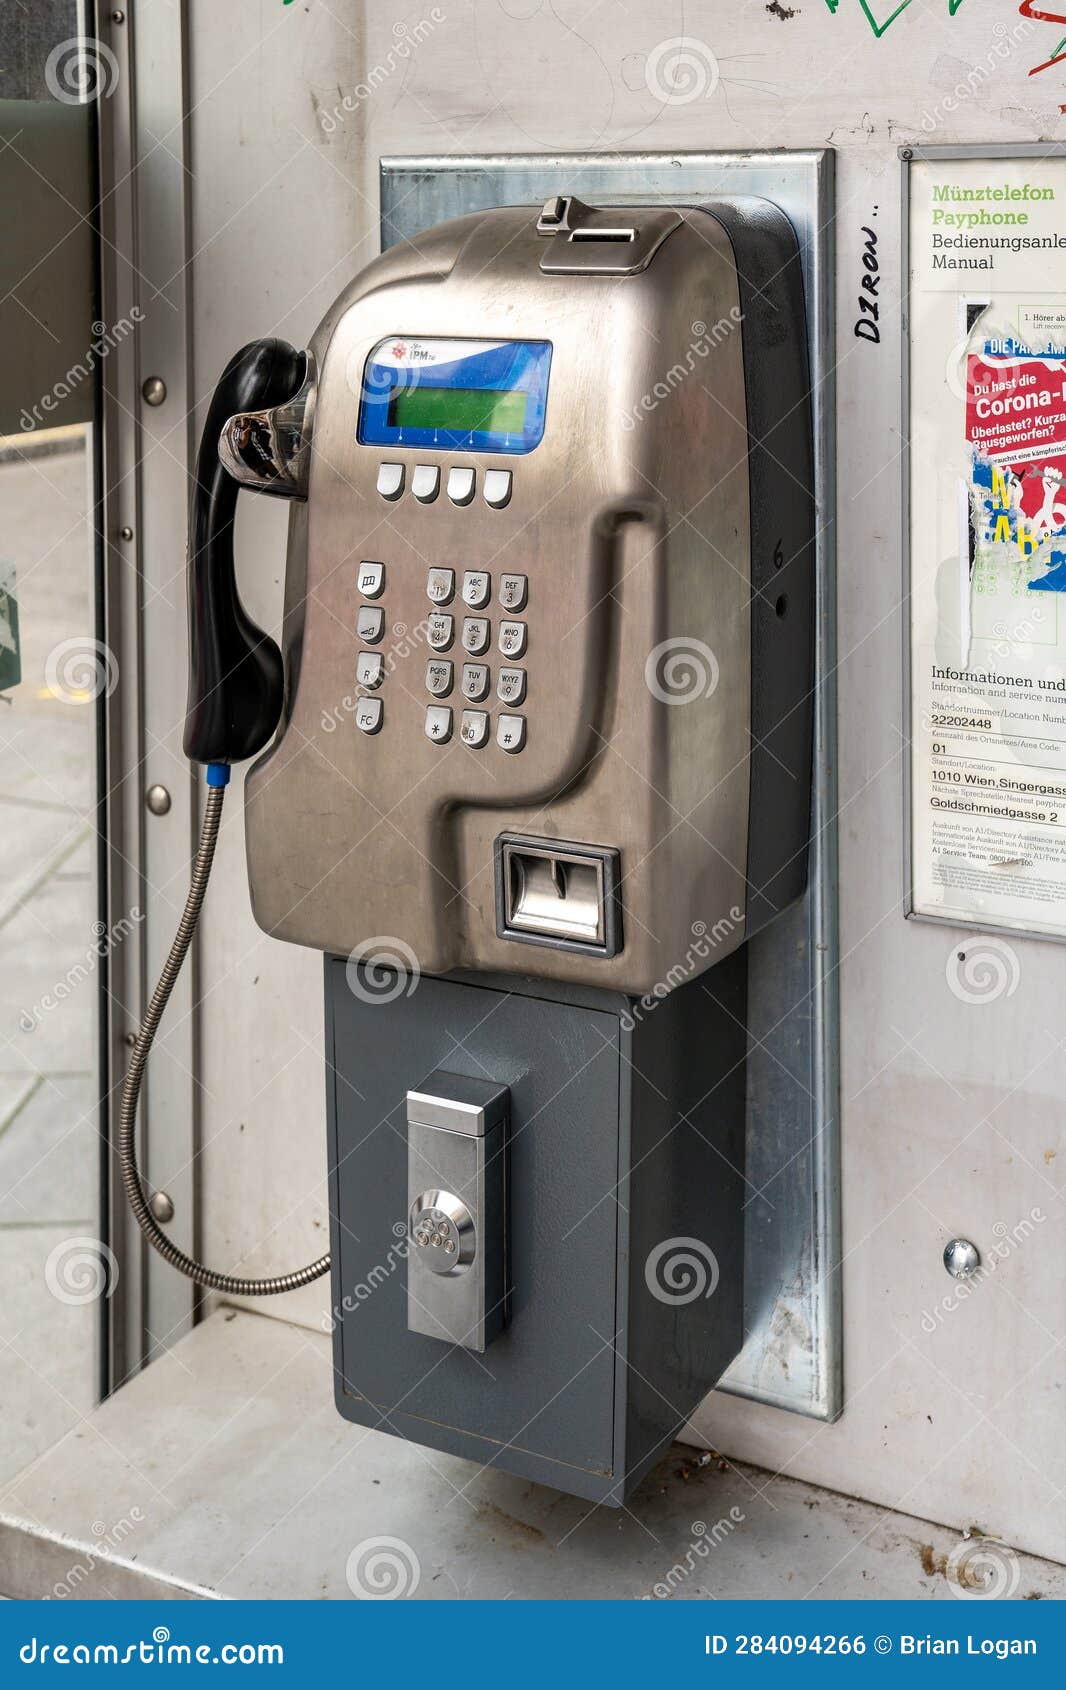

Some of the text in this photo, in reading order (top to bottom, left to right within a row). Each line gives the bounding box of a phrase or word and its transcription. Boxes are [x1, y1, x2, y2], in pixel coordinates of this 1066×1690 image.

[932, 184, 1055, 201] Münztelefon
[932, 209, 1028, 229] Payphone
[932, 254, 994, 270] Manual
[990, 338, 1009, 354] DIE
[974, 374, 1036, 396] Du hast die
[976, 382, 1066, 418] Corona-
[972, 417, 1032, 438] Überlastet?
[1018, 451, 1031, 460] eine
[469, 579, 482, 587] ABC
[505, 581, 518, 589] DEF
[470, 589, 477, 600] 2
[506, 592, 513, 603] 3
[468, 625, 481, 633] JKL
[469, 636, 476, 646] 5
[506, 639, 512, 650] 6
[363, 670, 370, 679] R
[430, 667, 447, 675] PQRS
[468, 671, 481, 679] TUV
[433, 678, 439, 687] 7
[502, 674, 519, 684] WXYZ
[932, 666, 1066, 692] Informationen und
[469, 682, 475, 693] 8
[505, 686, 512, 696] 9
[932, 682, 985, 696] Information
[988, 688, 1006, 698] and
[1008, 691, 1042, 702] service
[932, 701, 1040, 721] Standortnummer/Location
[361, 715, 373, 726] FC
[931, 714, 992, 729] 22202448
[468, 729, 475, 739] 0
[932, 730, 964, 740] Kennzahl
[966, 733, 978, 742] des
[932, 744, 946, 754] 01
[932, 770, 961, 782] 1010
[930, 797, 1058, 822] Goldschmiedgasse 2
[942, 848, 967, 857] Service
